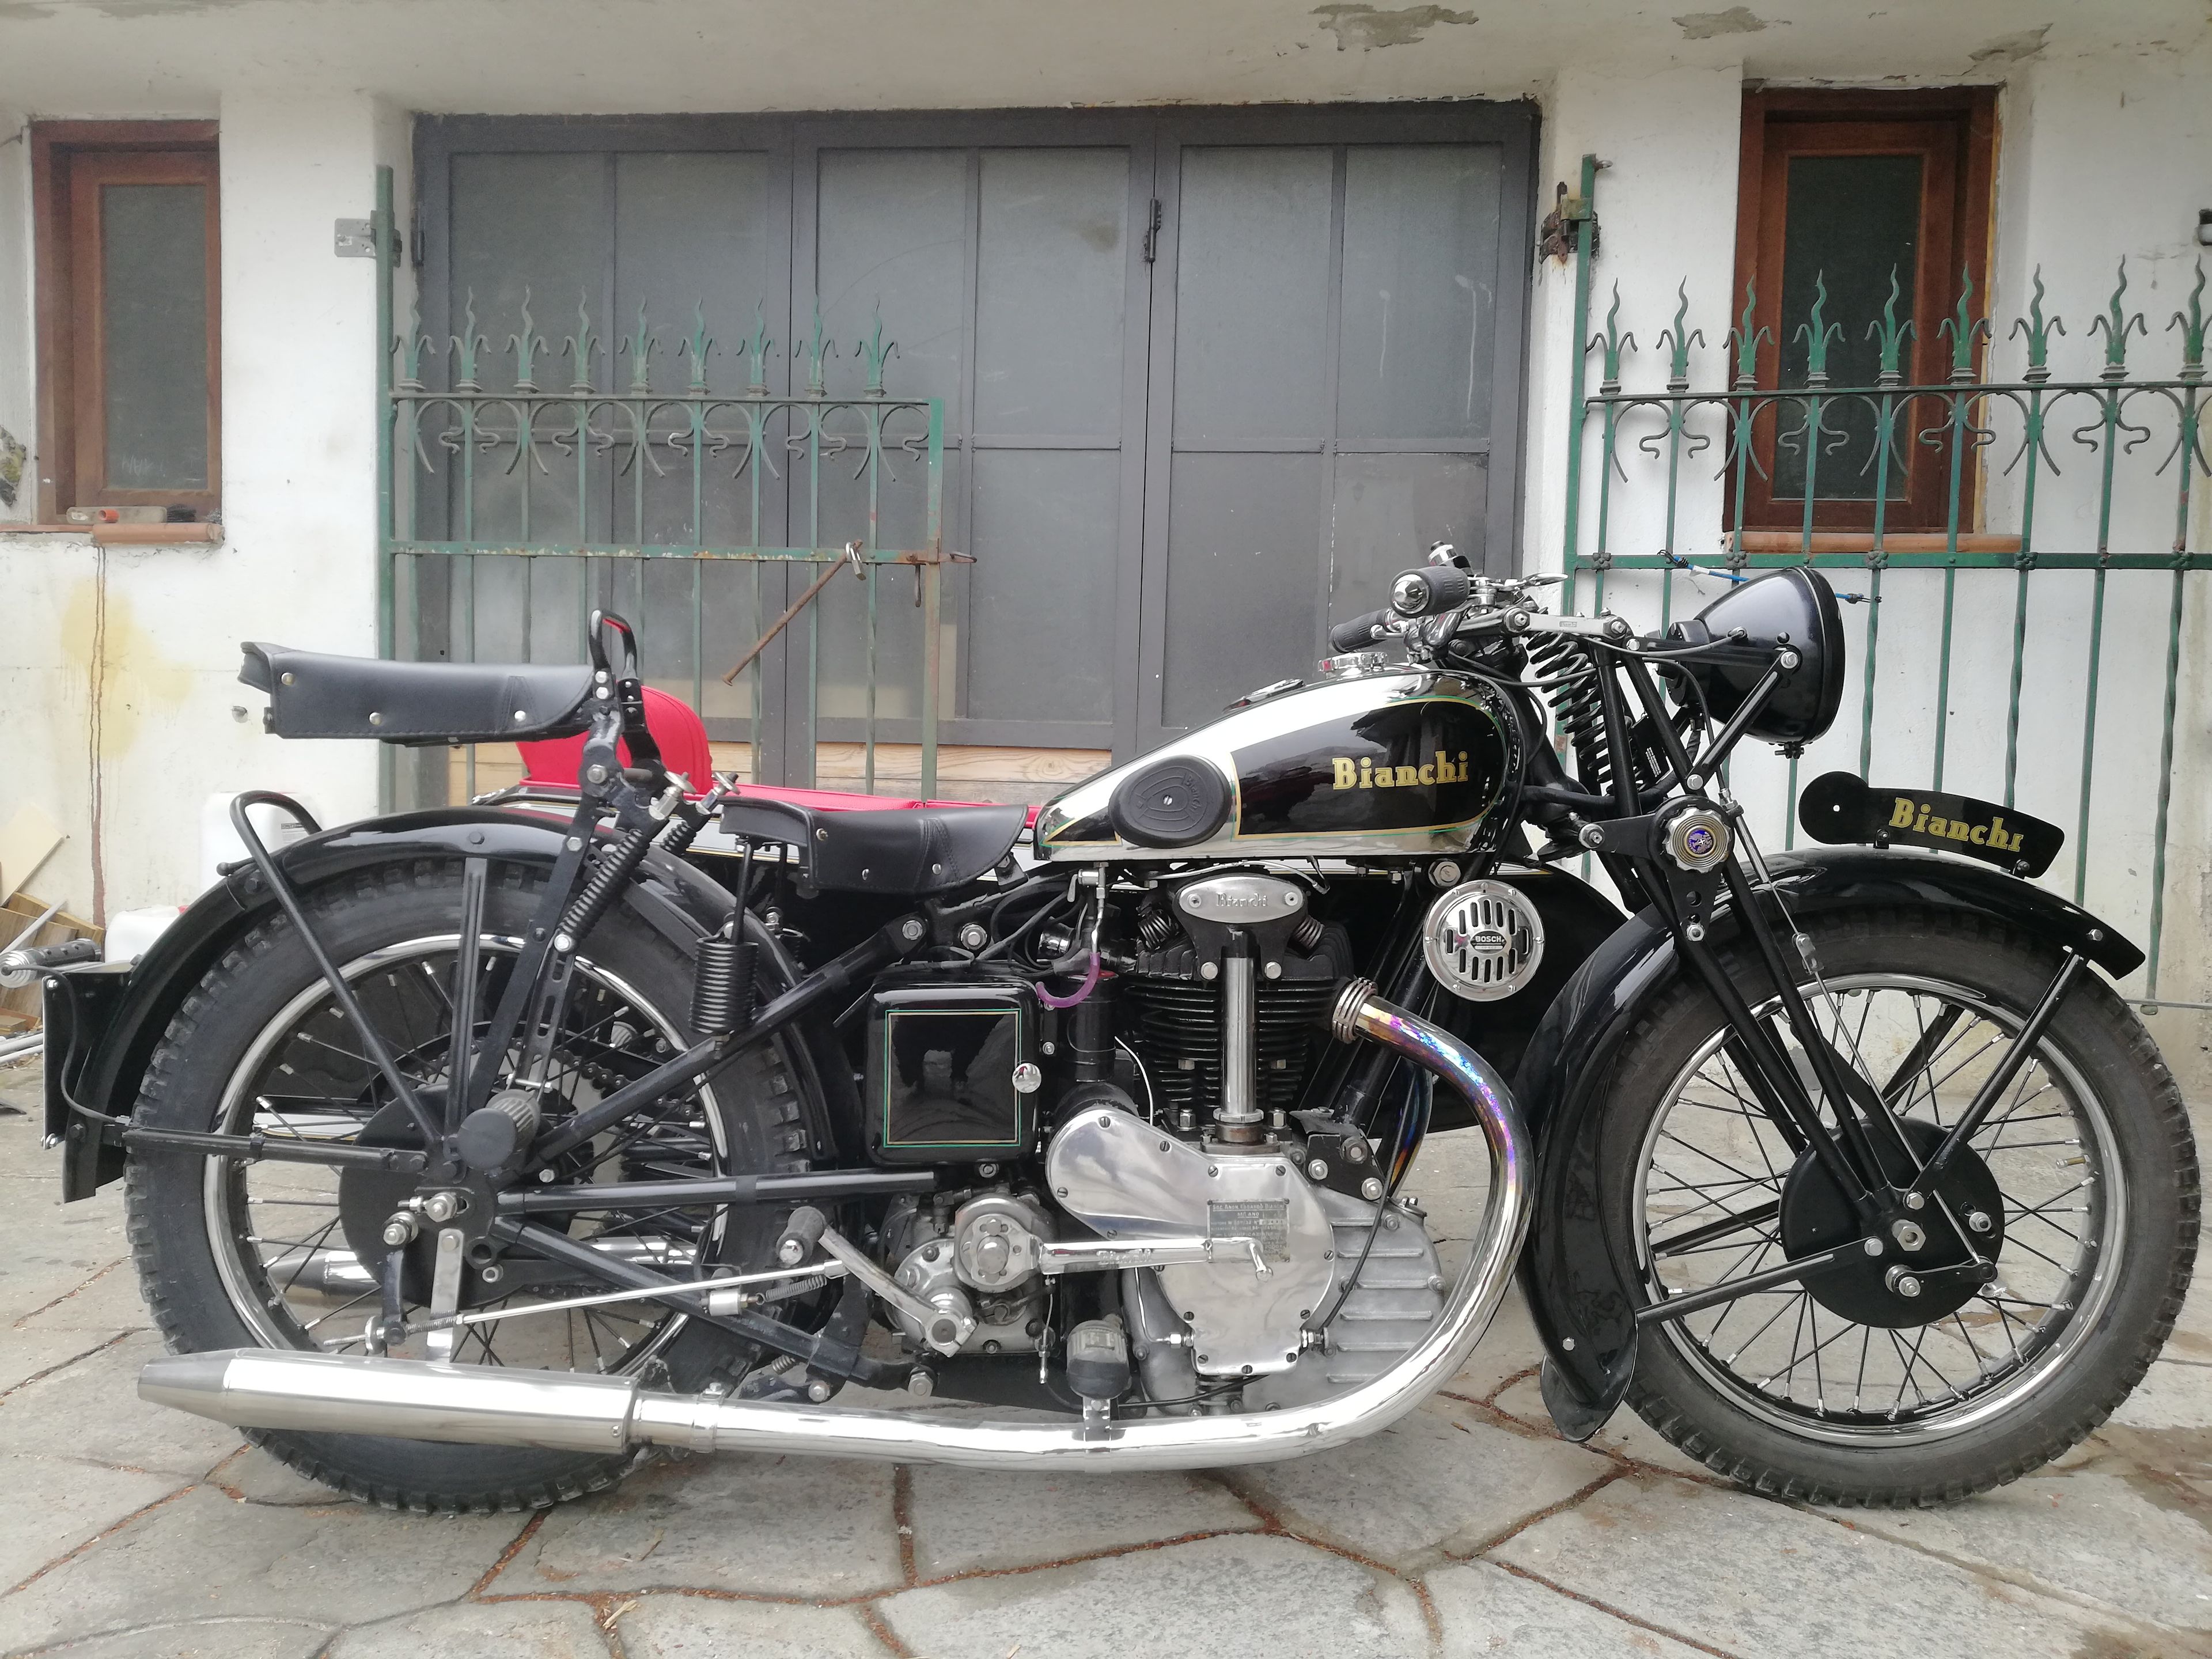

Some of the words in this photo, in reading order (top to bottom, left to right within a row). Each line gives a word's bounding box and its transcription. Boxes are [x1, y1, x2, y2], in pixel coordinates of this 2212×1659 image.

[1332, 751, 1468, 790] Bianchi
[1888, 797, 2024, 853] Bianchi
[1216, 893, 1268, 907] Bianchi
